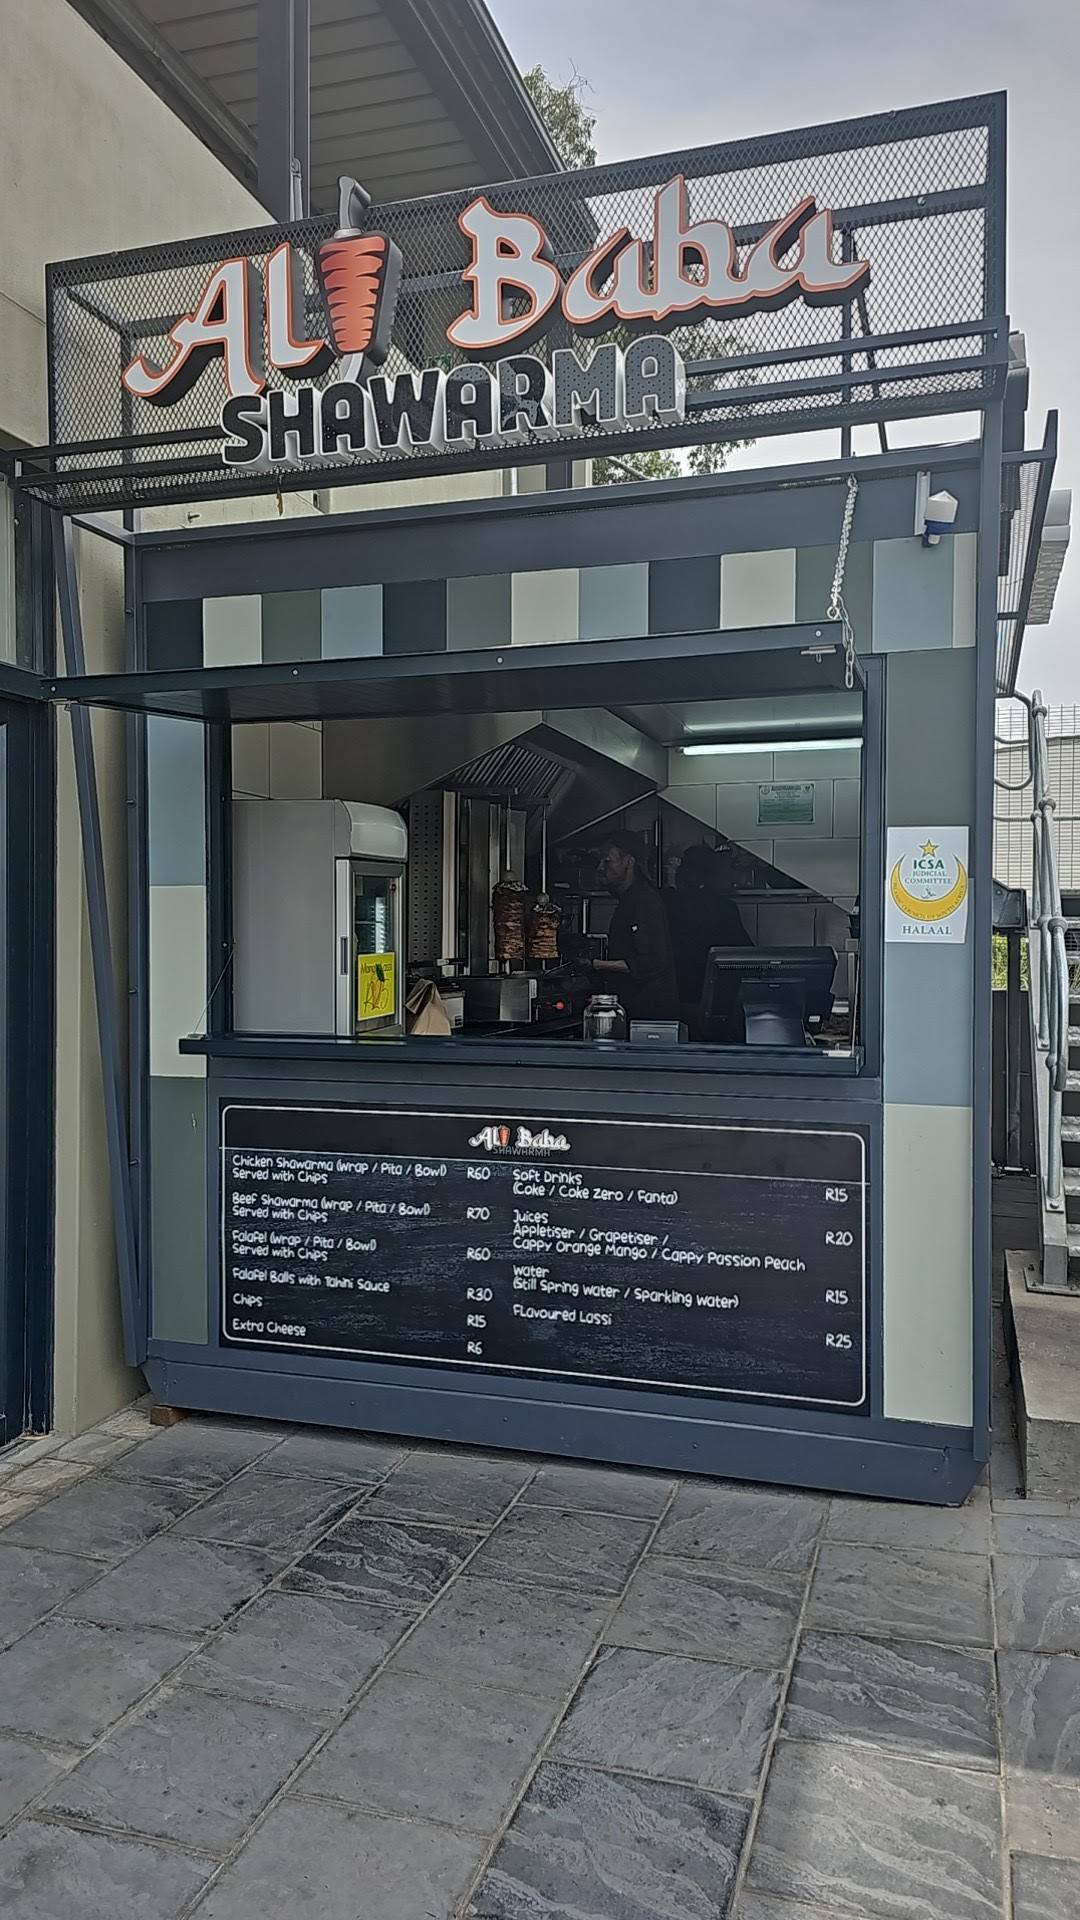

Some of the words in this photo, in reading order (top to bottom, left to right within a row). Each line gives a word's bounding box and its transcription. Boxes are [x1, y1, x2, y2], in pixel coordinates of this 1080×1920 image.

[447, 172, 870, 352] Baba
[222, 334, 686, 469] SHAWARMA
[914, 859, 944, 869] ICSA
[903, 926, 952, 934] HALAAL
[515, 1126, 571, 1151] Baba
[493, 1146, 551, 1157] SHAWARMA
[233, 1155, 273, 1167] Chicken
[276, 1158, 333, 1171] Shawarma
[381, 1164, 402, 1175] Pita
[415, 1164, 447, 1177] Bowl)
[467, 1167, 490, 1180] R60
[233, 1168, 268, 1180] Served
[272, 1171, 294, 1182] with
[298, 1171, 327, 1184] Chips
[513, 1169, 541, 1182] Soft
[544, 1171, 582, 1185] Drinks
[513, 1182, 545, 1196] (Coke
[558, 1185, 589, 1199] Coke
[593, 1188, 623, 1201] Zero
[638, 1190, 678, 1205] Fanta)
[826, 1188, 848, 1202] R15
[232, 1192, 258, 1204] Beef
[261, 1194, 318, 1209] Shawarma
[365, 1201, 386, 1213] Pita
[399, 1202, 430, 1215] Bowl)
[232, 1206, 268, 1218] Served
[272, 1209, 294, 1219] with
[298, 1210, 327, 1222] Chips
[467, 1207, 490, 1220] R70
[513, 1209, 548, 1223] Juices
[232, 1230, 267, 1243] Falafel
[313, 1236, 334, 1248] Pita
[346, 1238, 376, 1251] Bowl)
[513, 1223, 576, 1238] Appletiser
[589, 1229, 658, 1245] Grapetiser
[826, 1231, 853, 1246] R20
[232, 1243, 269, 1256] Served
[272, 1247, 295, 1259] with
[298, 1248, 328, 1261] Chips
[467, 1248, 490, 1260] R60
[513, 1237, 552, 1251] Cappy
[556, 1243, 601, 1256] Orange
[605, 1245, 647, 1259] Mango
[662, 1249, 704, 1264] Cappy
[708, 1253, 761, 1268] Passion
[765, 1256, 806, 1271] Peach
[232, 1268, 267, 1281] Falafel
[270, 1271, 295, 1284] Balls
[299, 1274, 321, 1286] with
[325, 1276, 353, 1288] Tahini
[357, 1279, 390, 1293] Sauce
[467, 1288, 493, 1301] R30
[513, 1276, 536, 1290] (Still
[540, 1280, 579, 1297] Spring
[634, 1288, 692, 1307] Sparkling
[826, 1290, 848, 1304] R15
[233, 1293, 262, 1307] Chips
[467, 1315, 486, 1328] R15
[580, 1311, 612, 1325] Lassi
[232, 1319, 264, 1332] Extra
[267, 1321, 306, 1336] Cheese
[467, 1342, 482, 1354] R6
[826, 1334, 852, 1349] R25
